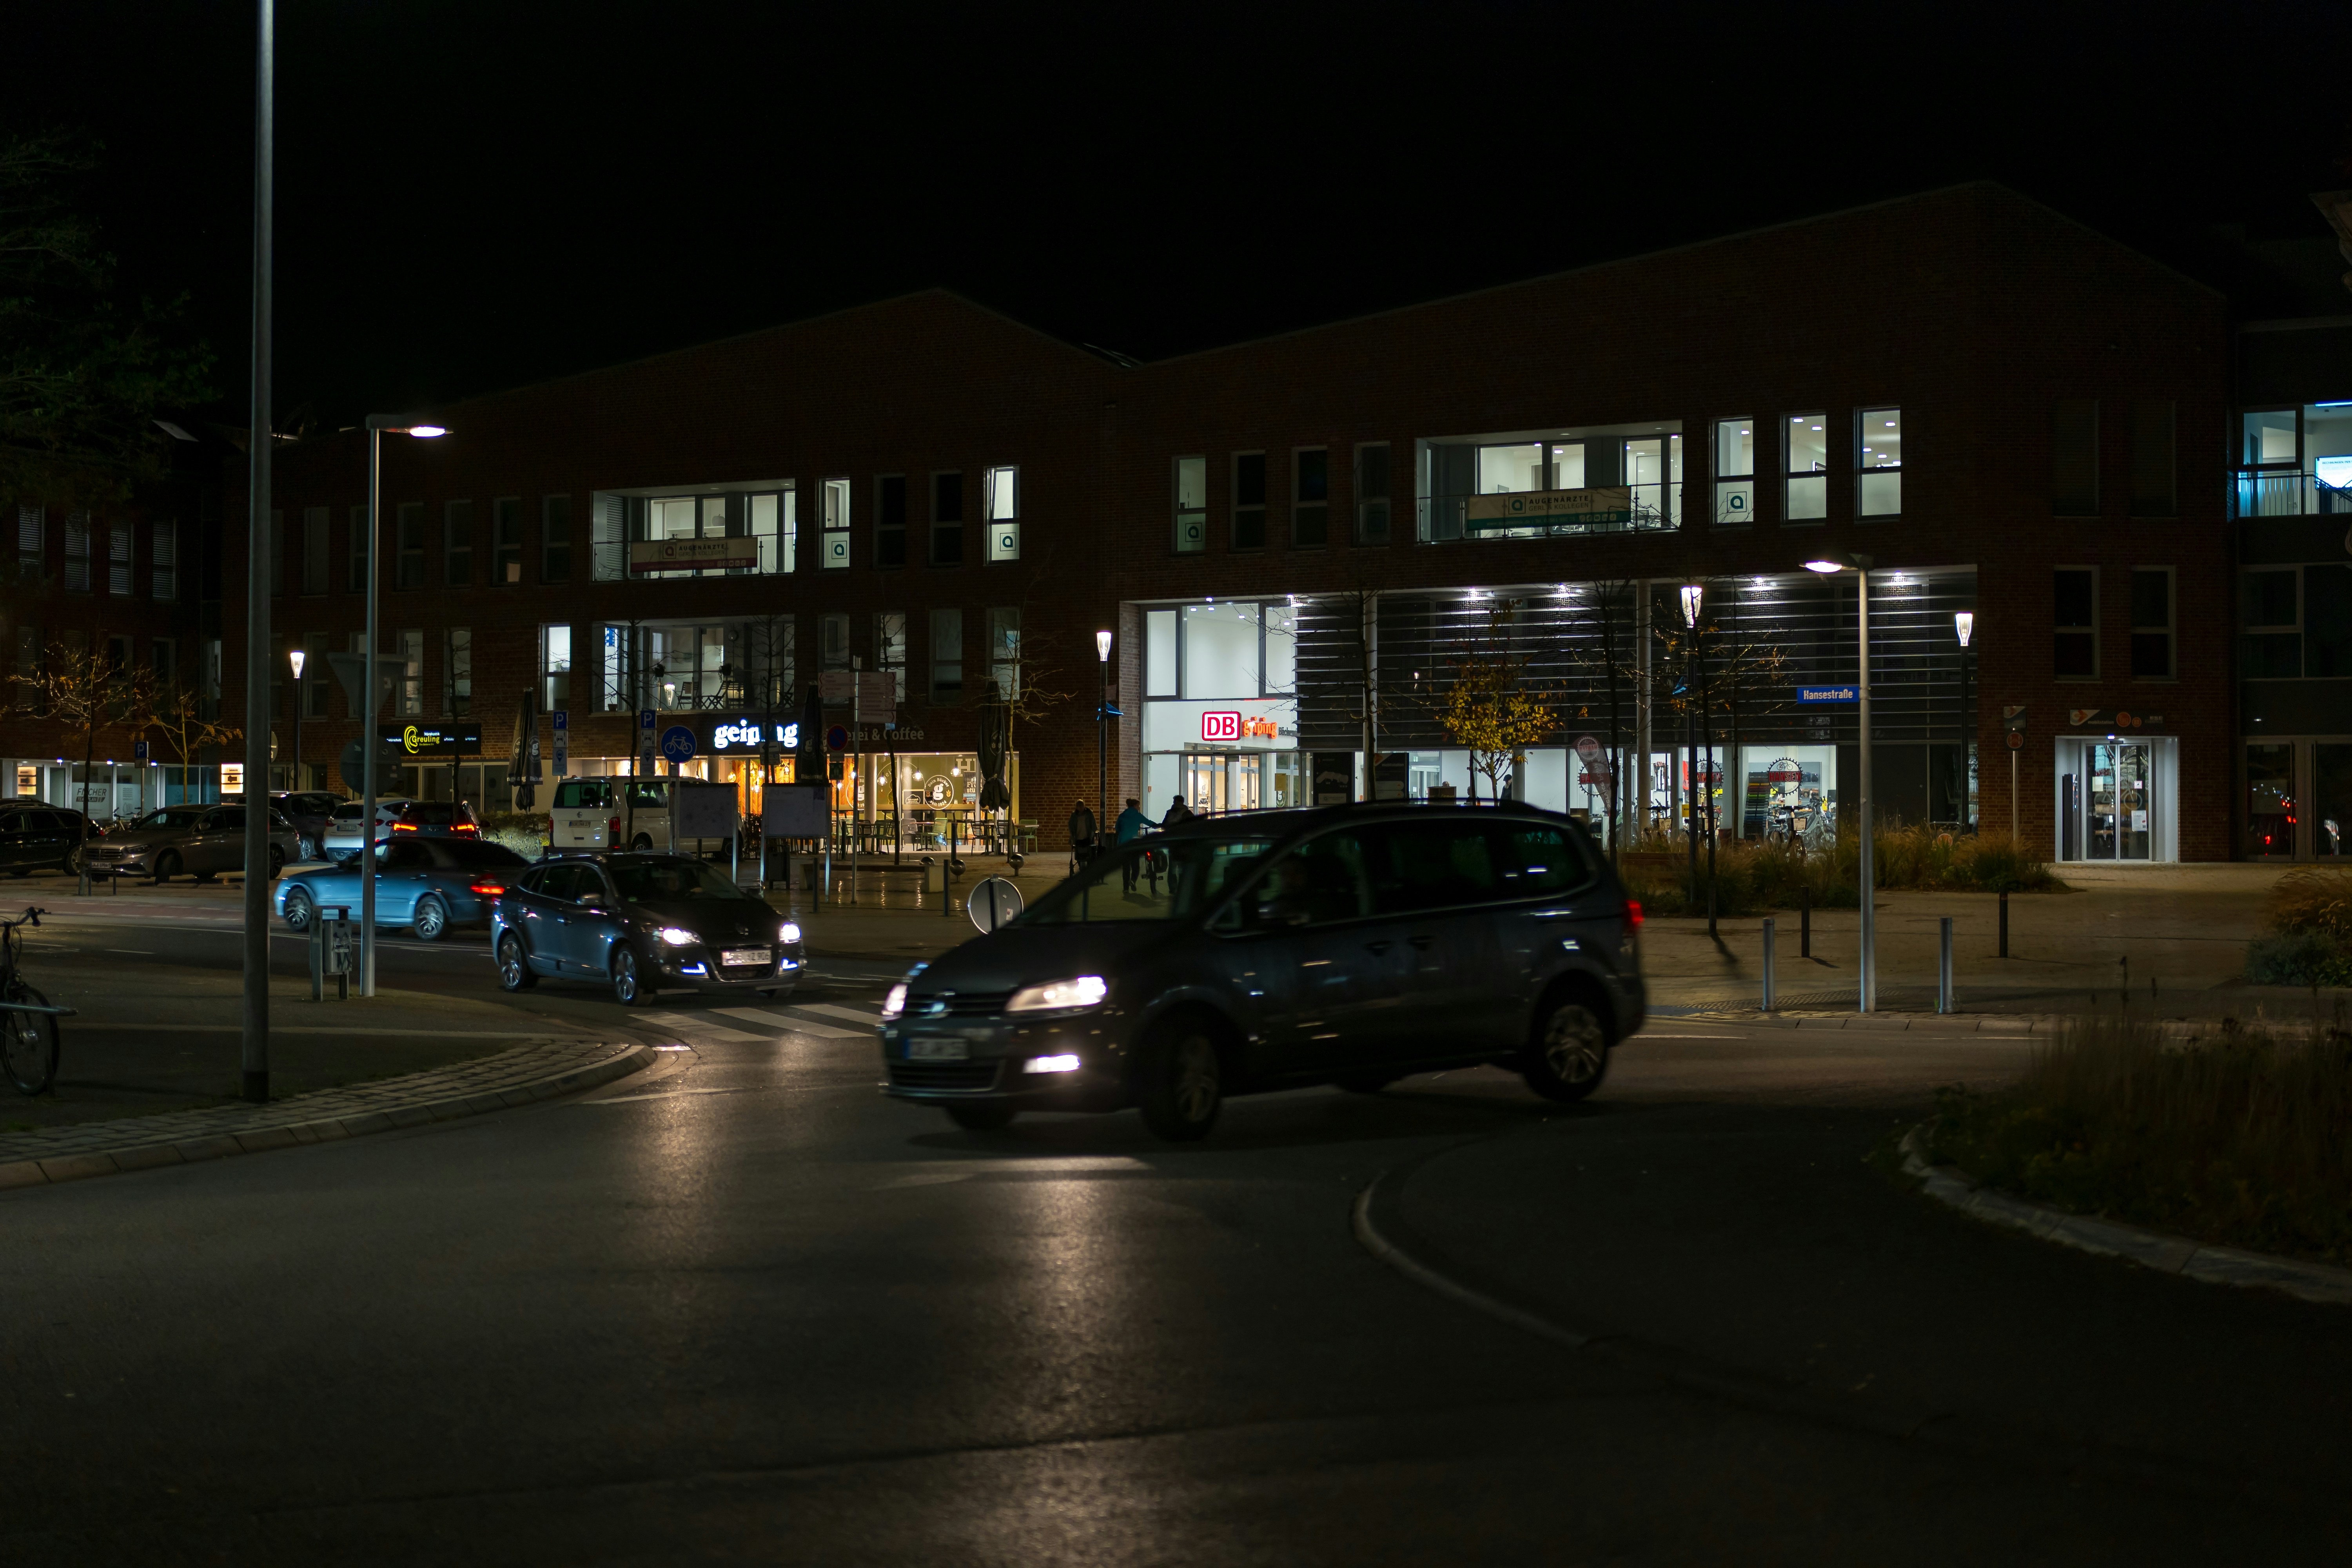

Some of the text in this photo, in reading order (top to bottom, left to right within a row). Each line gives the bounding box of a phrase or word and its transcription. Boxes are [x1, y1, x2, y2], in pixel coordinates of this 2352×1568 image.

[1529, 495, 1589, 505] AUGENÄRZTE
[1803, 689, 1853, 700] Hansestraße
[556, 713, 564, 727] P
[644, 713, 652, 727] P
[1207, 717, 1235, 736] DB
[713, 718, 799, 749] geipg
[871, 728, 880, 740] &
[412, 735, 440, 744] Greuling
[1769, 771, 1801, 782] HANSEN
[927, 777, 949, 788] Dein Bäcker
